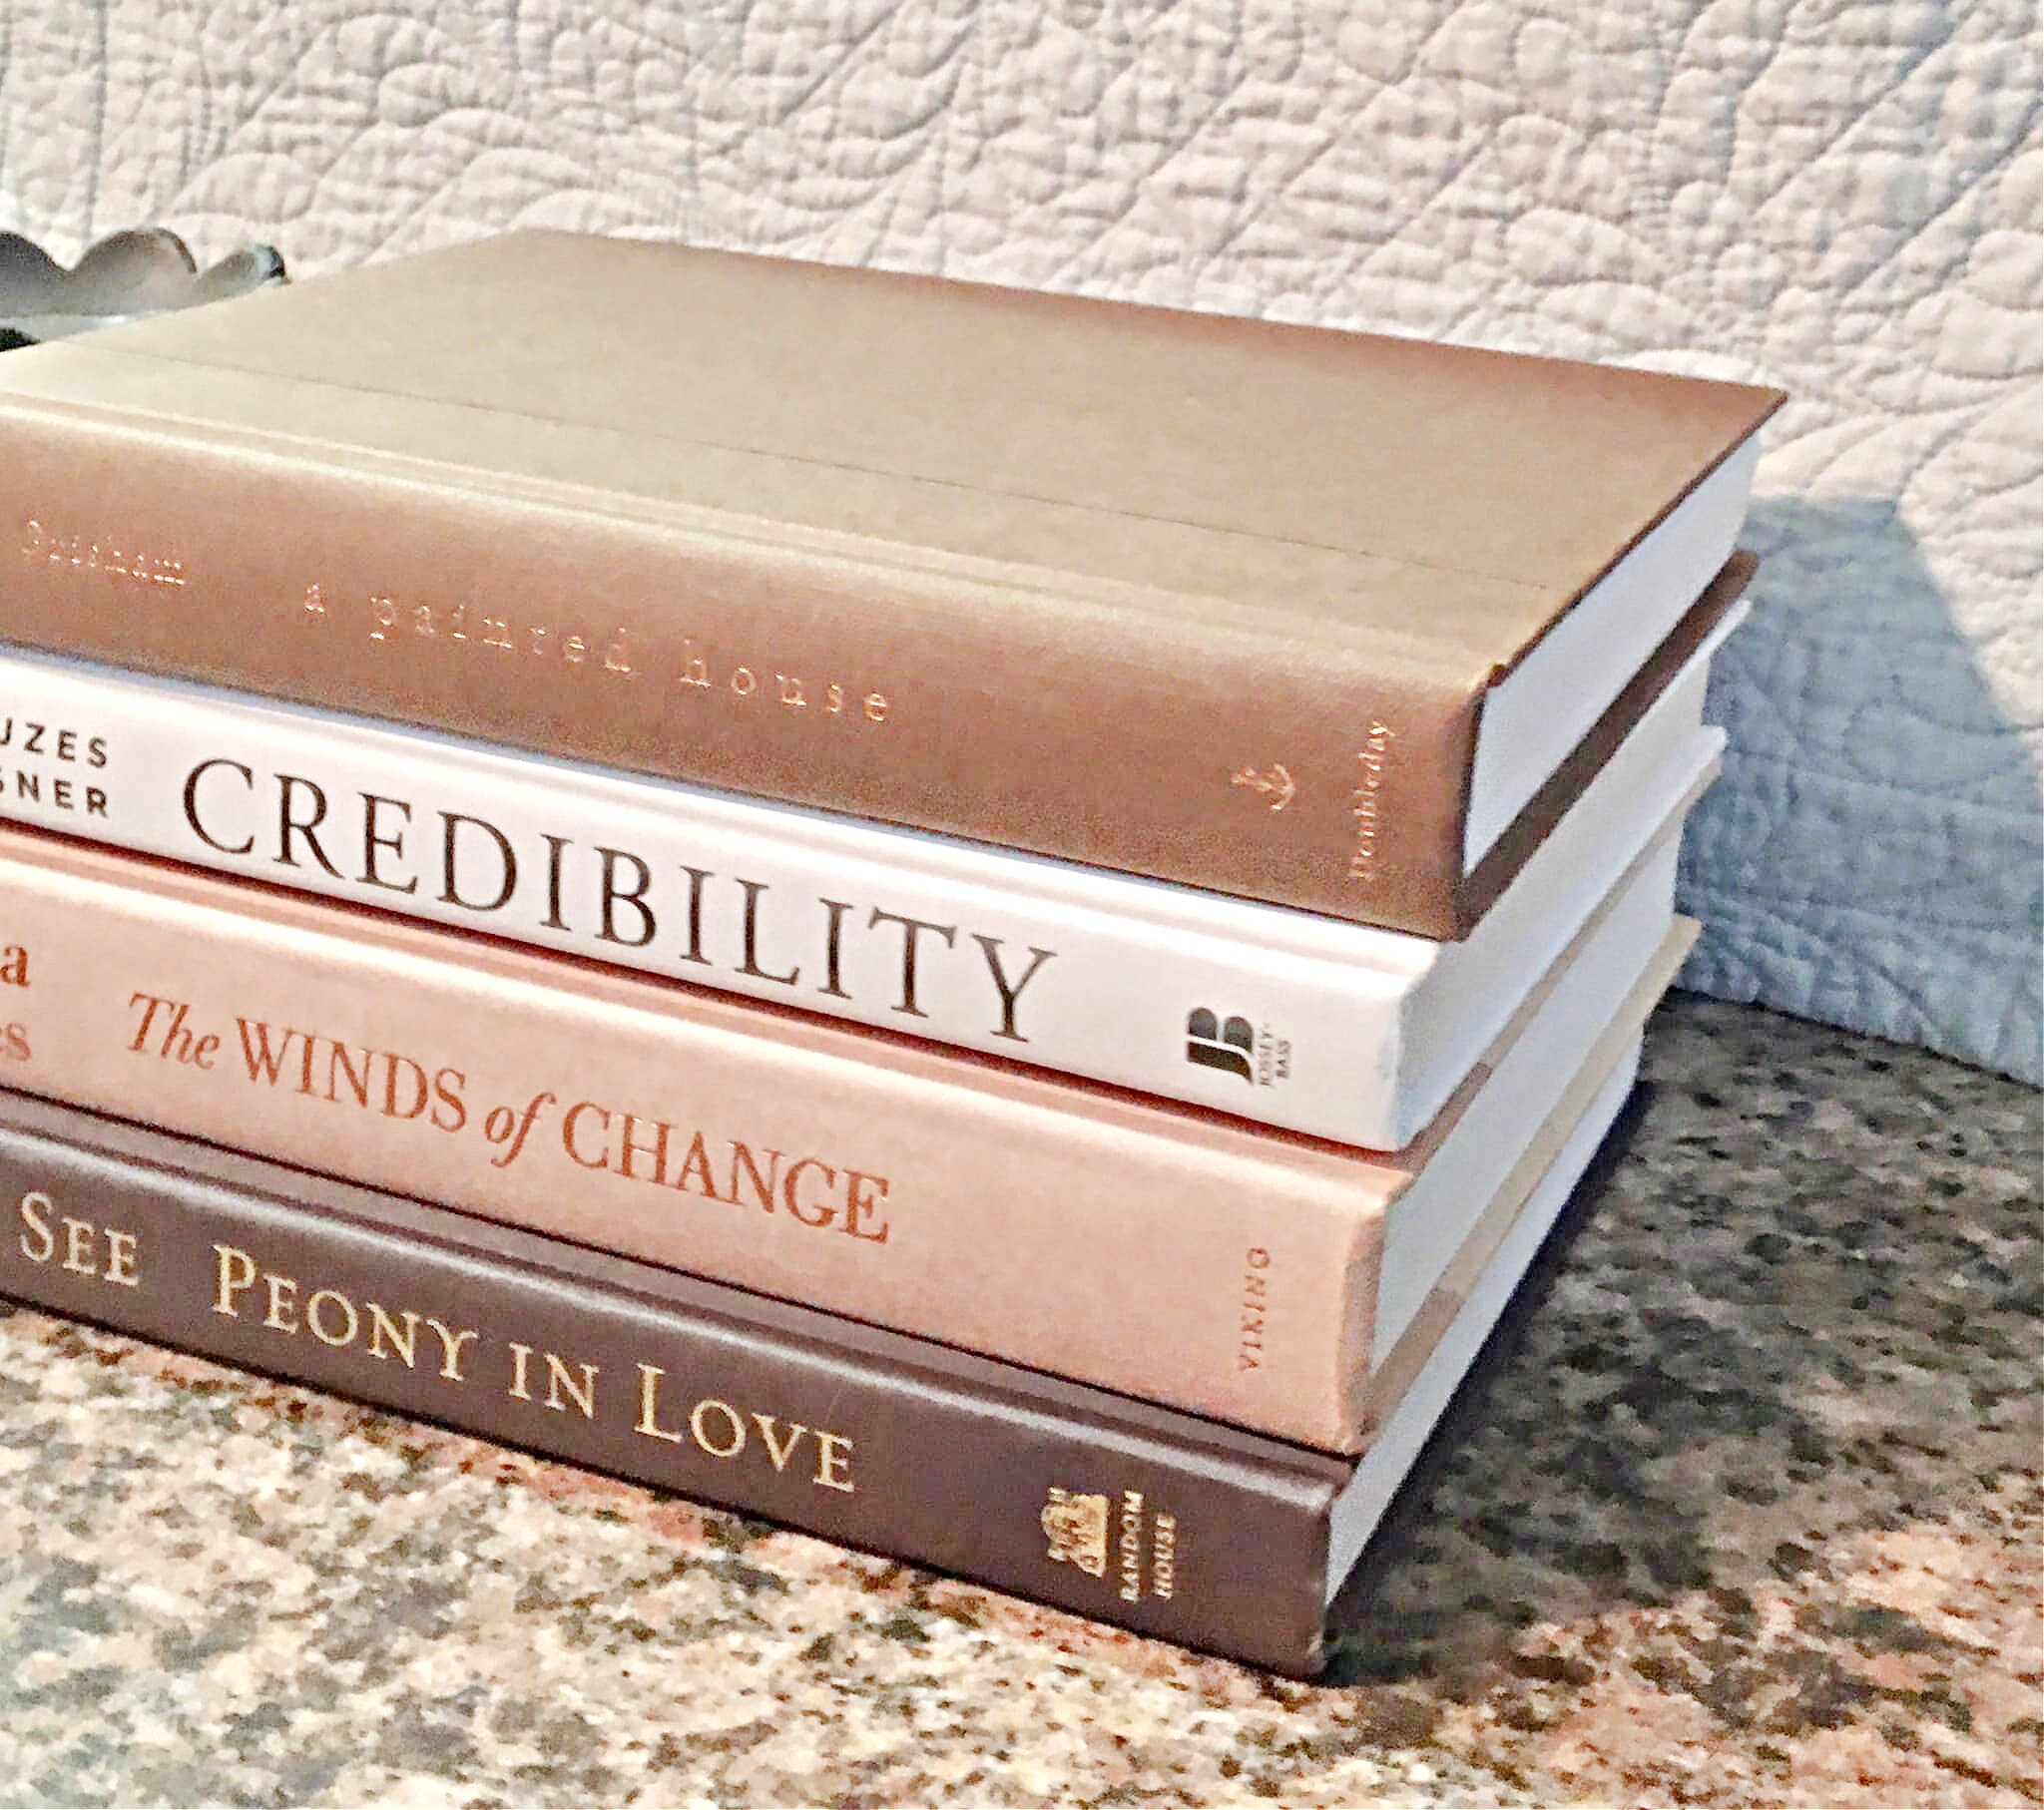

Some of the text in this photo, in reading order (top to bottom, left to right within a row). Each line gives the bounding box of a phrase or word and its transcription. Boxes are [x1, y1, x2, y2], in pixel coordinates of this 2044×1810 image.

[679, 636, 889, 723] house
[0, 766, 109, 818] NER
[183, 757, 1058, 1044] CREDIBILITY
[128, 991, 889, 1245] The WINDS of CHANGE
[1119, 1489, 1145, 1602] RANDOM
[1152, 1512, 1177, 1600] HOUSE
